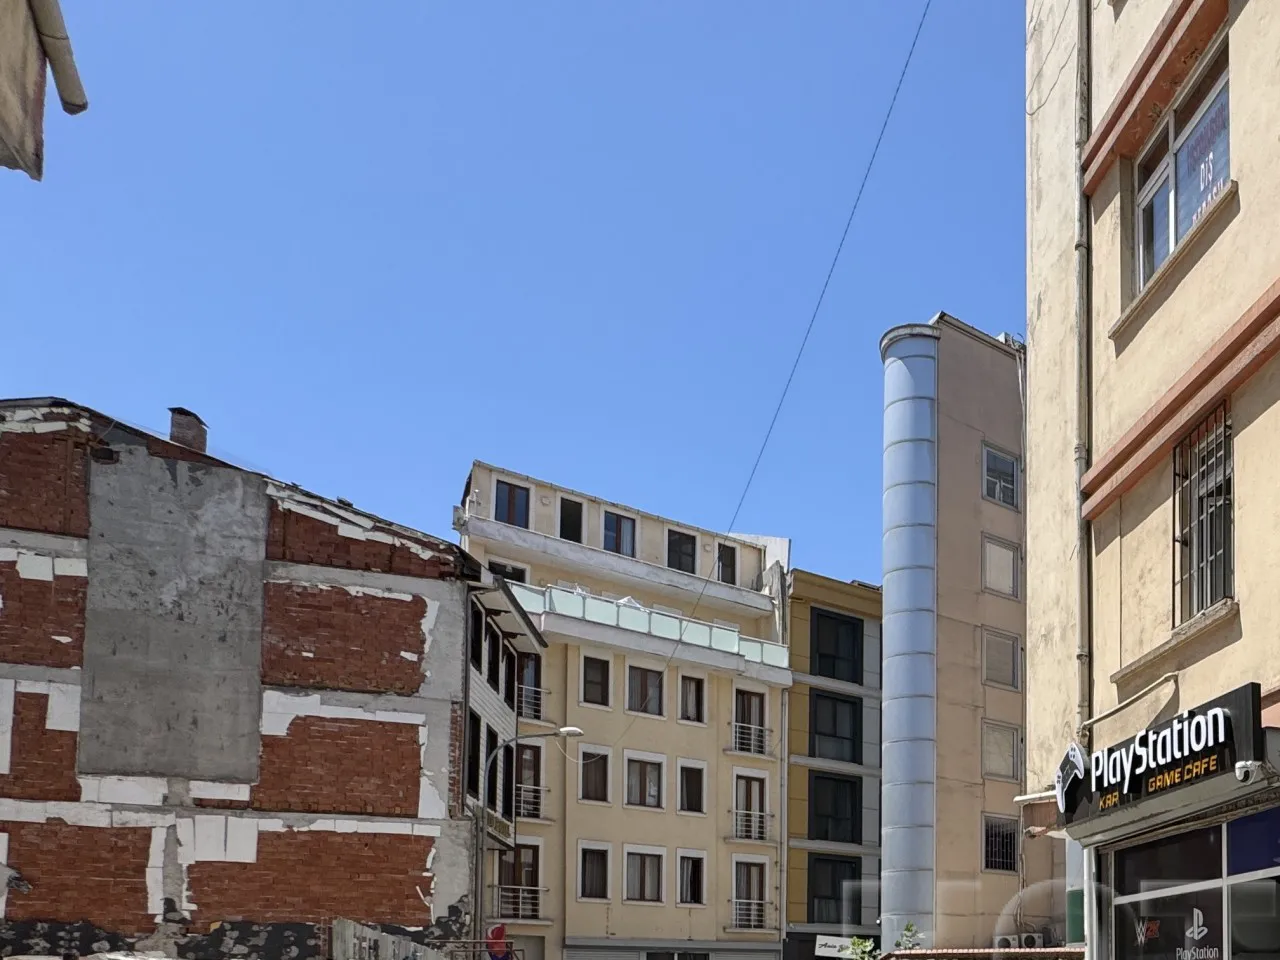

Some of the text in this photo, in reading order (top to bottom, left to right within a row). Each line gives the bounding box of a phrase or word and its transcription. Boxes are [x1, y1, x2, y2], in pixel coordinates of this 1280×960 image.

[1091, 707, 1225, 795] PlayStation
[1148, 754, 1217, 793] GAME CAFE
[1099, 791, 1119, 810] KAR
